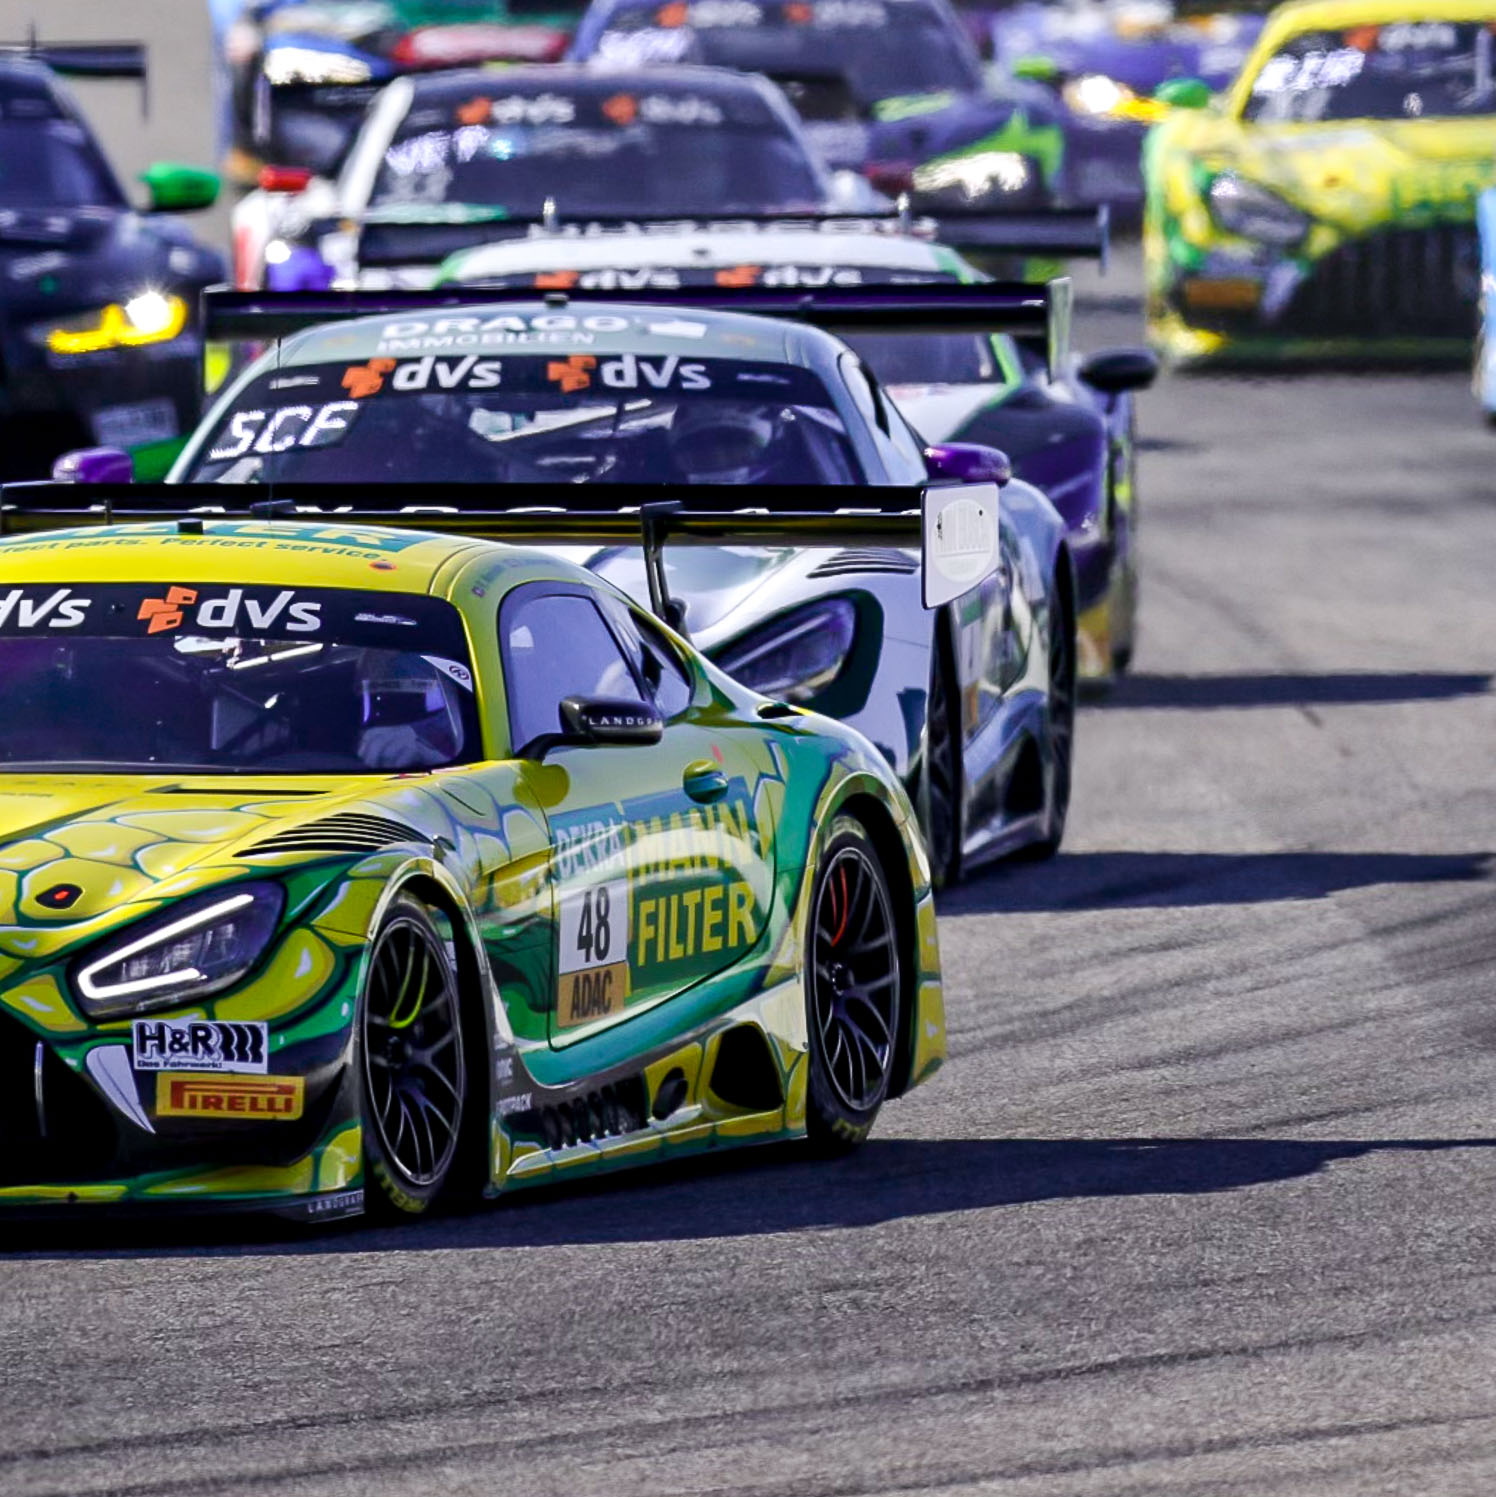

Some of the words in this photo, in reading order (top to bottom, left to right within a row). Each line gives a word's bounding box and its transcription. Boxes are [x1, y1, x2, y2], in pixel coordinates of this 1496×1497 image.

[580, 269, 680, 289] dvs
[764, 265, 862, 289] dvs
[377, 331, 596, 353] IMMOBILIEN
[382, 315, 629, 339] DRAGO
[392, 355, 502, 390] dvs
[600, 355, 712, 391] dvs
[210, 401, 359, 459] SCF
[160, 536, 268, 549] Perfect
[273, 542, 388, 561] service.
[196, 588, 322, 633] dvs
[577, 886, 611, 963] 48
[637, 880, 758, 967] FILTER
[569, 969, 612, 1021] ADAC
[137, 1021, 217, 1057] H&R
[169, 1080, 297, 1113] PIRELLI
